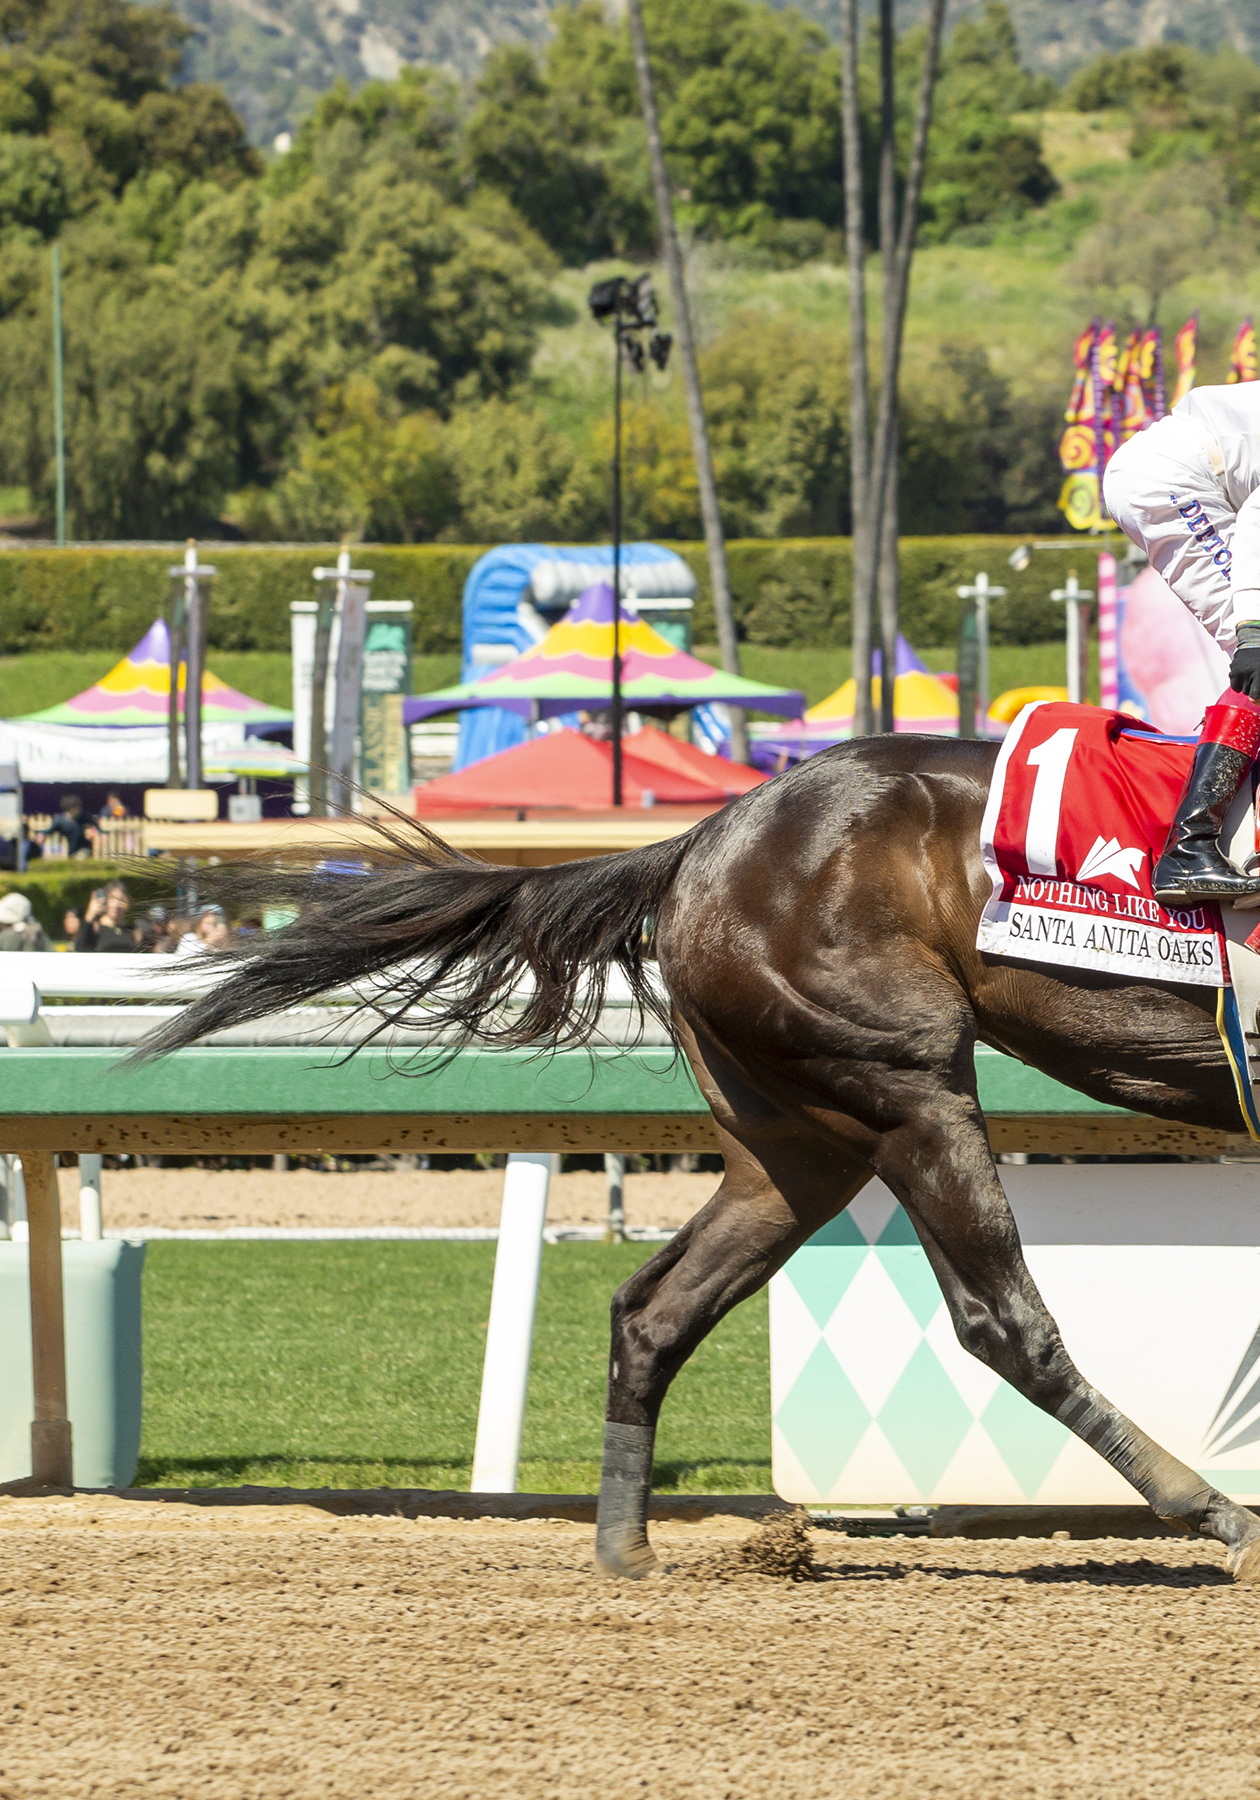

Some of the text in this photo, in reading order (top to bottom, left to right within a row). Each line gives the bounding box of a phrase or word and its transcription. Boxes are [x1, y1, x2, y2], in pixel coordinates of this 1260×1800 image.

[1026, 728, 1079, 876] 1
[1014, 876, 1206, 930] NOTHING LIKE YOU
[1009, 911, 1215, 967] SANTA ANITA OAKS
